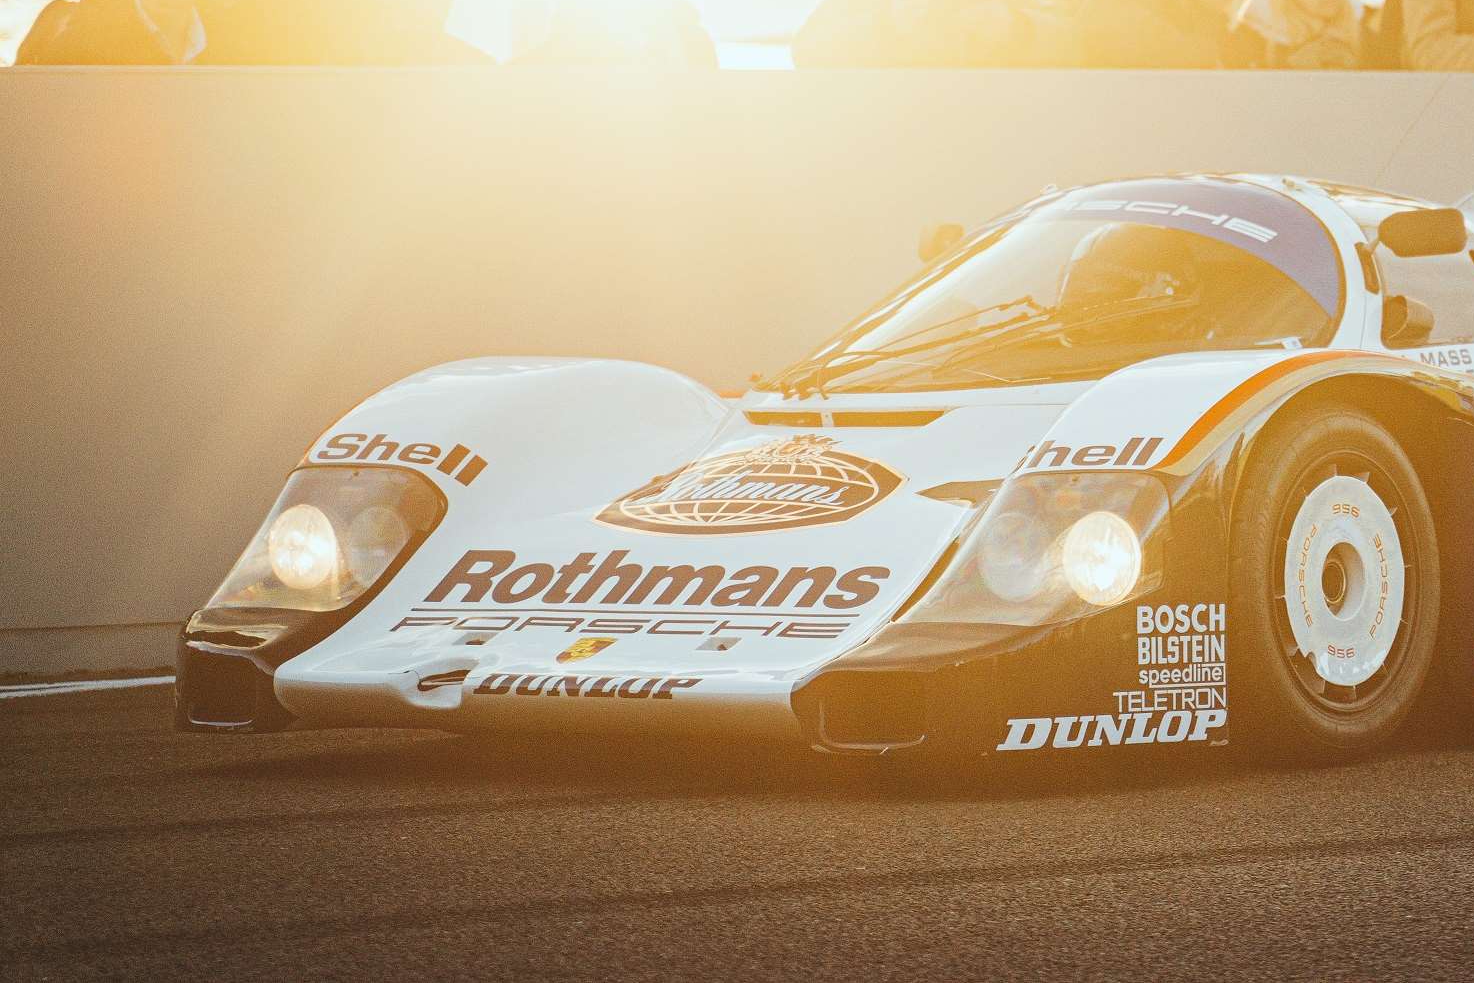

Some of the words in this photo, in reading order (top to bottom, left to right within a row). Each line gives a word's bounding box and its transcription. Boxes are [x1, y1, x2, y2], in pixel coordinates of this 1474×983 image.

[1420, 348, 1473, 368] MASS
[316, 432, 489, 487] Shell
[423, 549, 891, 609] Rothmans
[1298, 523, 1319, 629] PORSCHE
[1369, 533, 1390, 641] PORSCHE
[390, 617, 850, 639] PORSCHE
[1136, 603, 1226, 634] BOSCH
[1137, 634, 1225, 666] BILSTEIN
[1138, 663, 1223, 687] speedline
[1112, 687, 1227, 713] TELETRON
[996, 709, 1228, 751] DUNLOP
